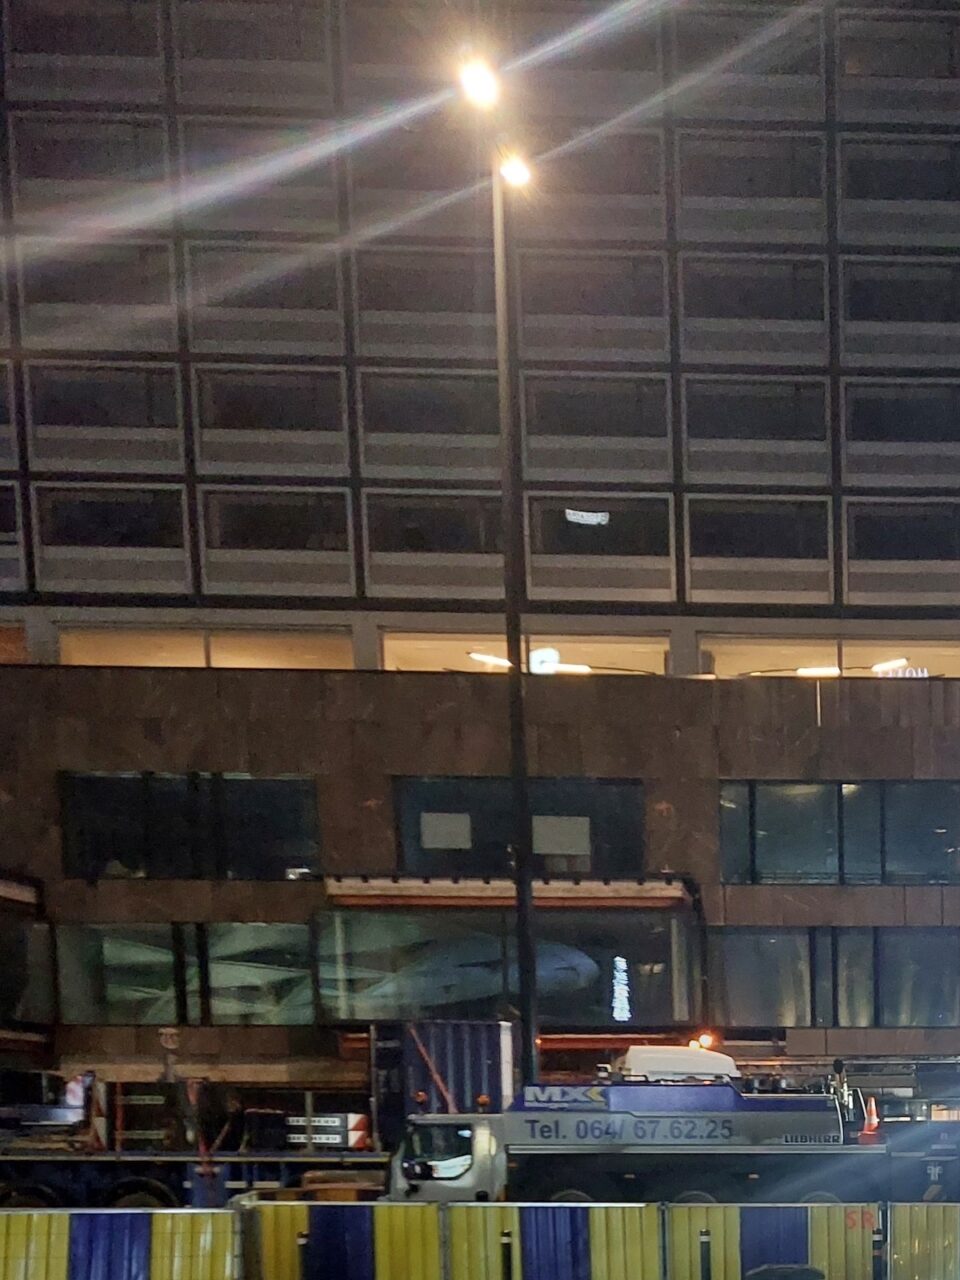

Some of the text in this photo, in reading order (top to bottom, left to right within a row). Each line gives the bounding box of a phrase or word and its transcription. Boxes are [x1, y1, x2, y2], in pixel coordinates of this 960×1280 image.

[524, 1119, 733, 1140] Tel. 064/ 67.62.25
[784, 1134, 841, 1144] LIEBHERR
